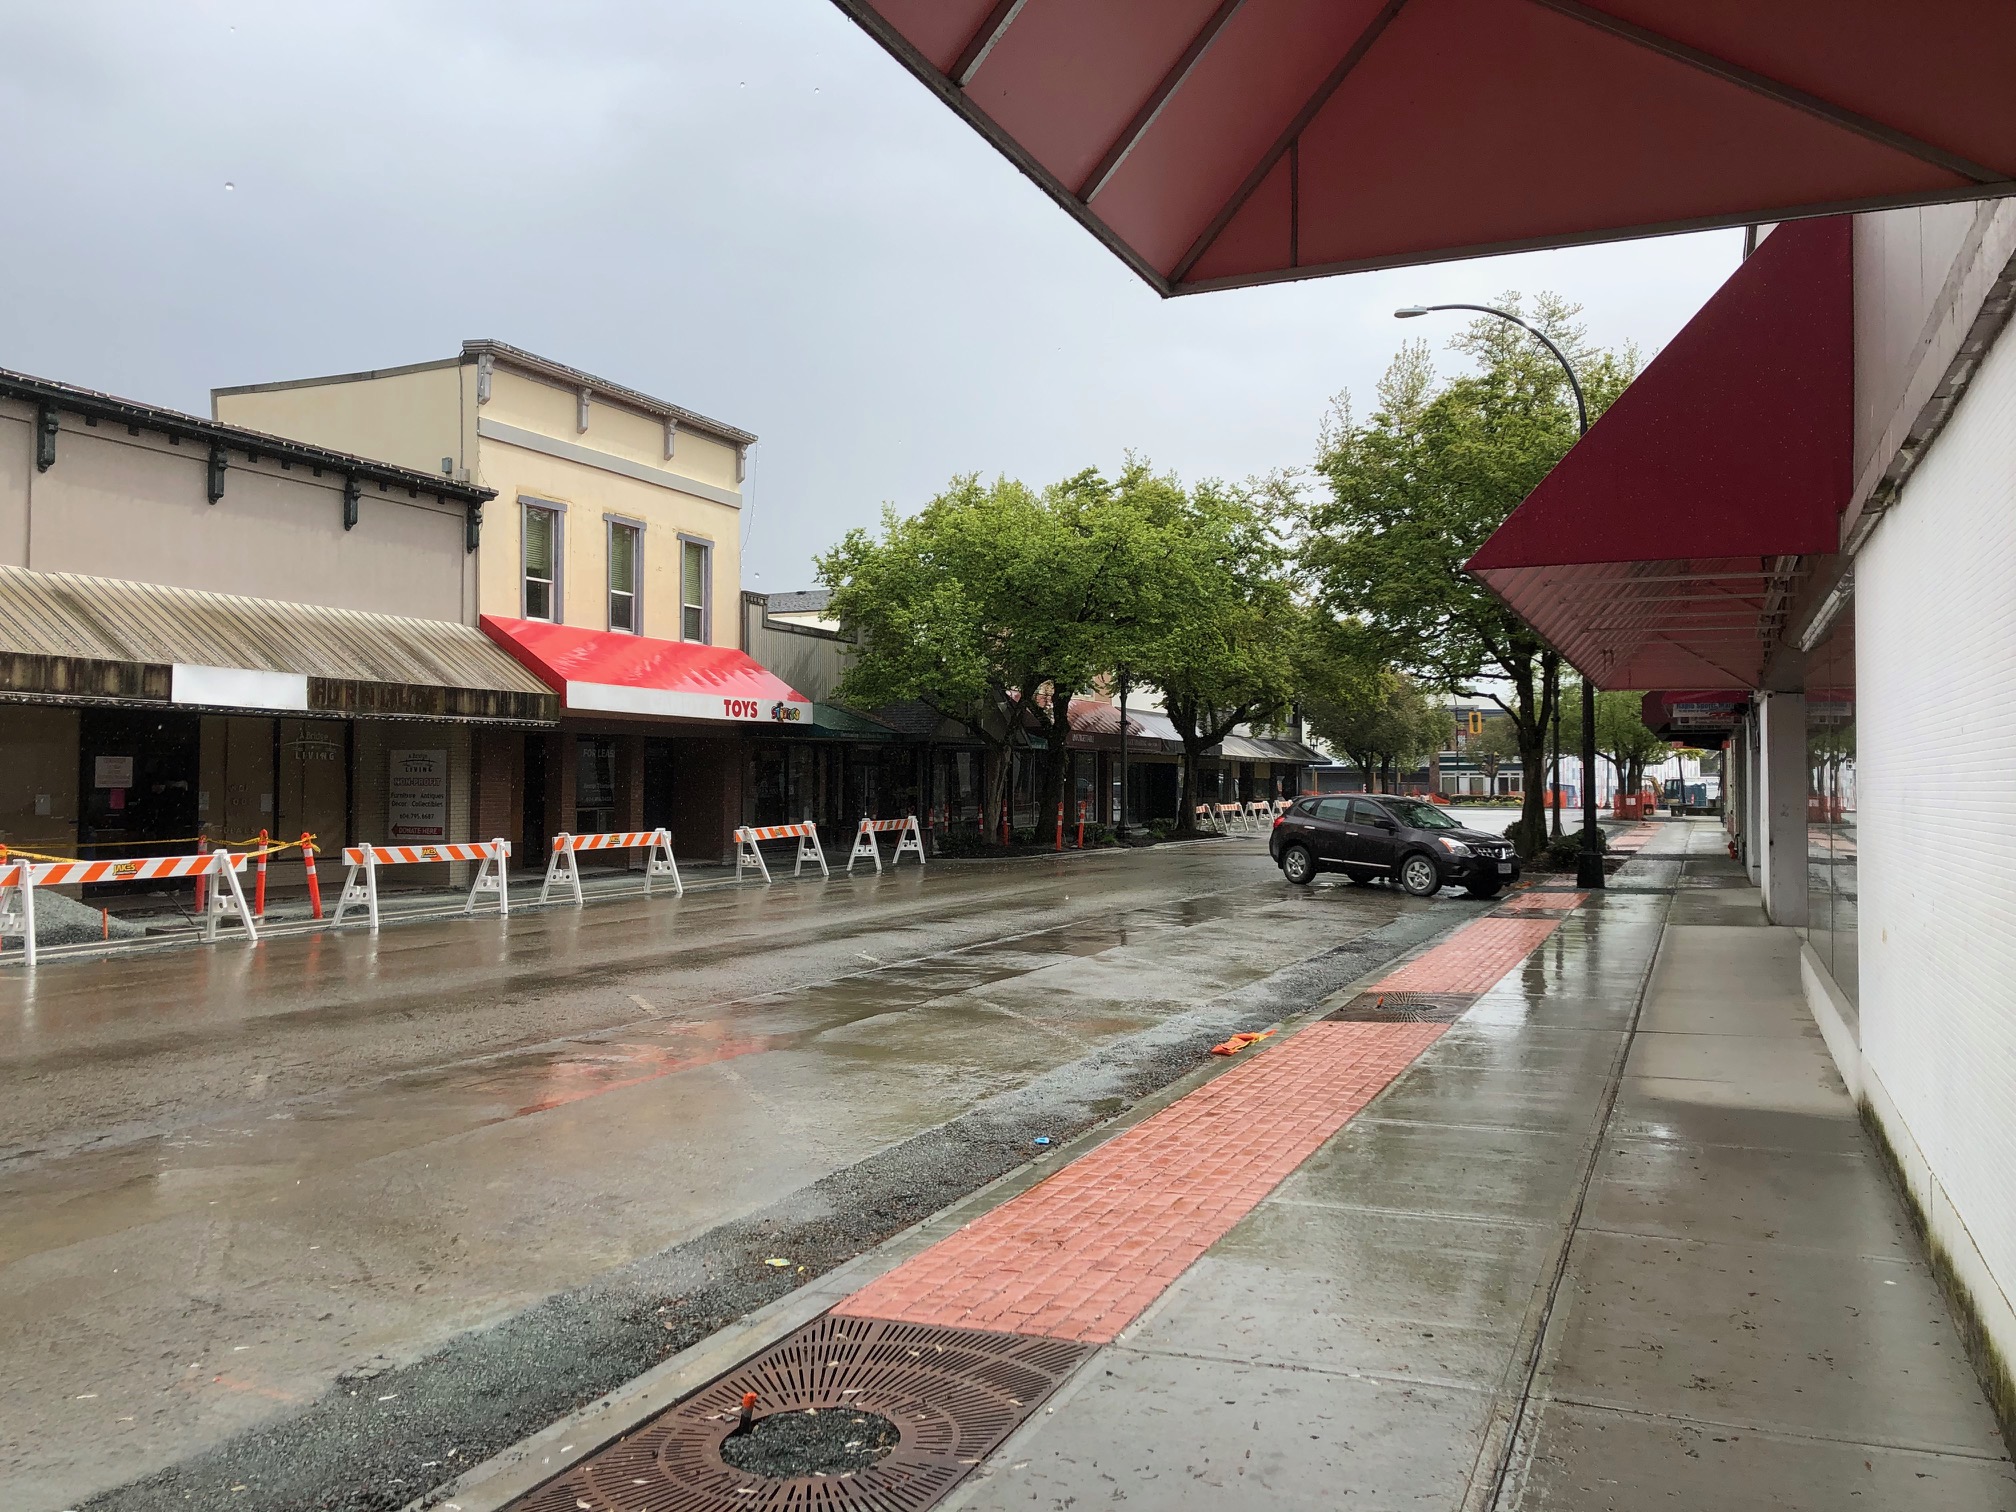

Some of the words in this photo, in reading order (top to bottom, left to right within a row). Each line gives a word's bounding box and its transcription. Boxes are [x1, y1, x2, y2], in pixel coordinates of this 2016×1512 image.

[723, 698, 758, 719] TOYS
[295, 751, 335, 760] LIVING
[583, 748, 597, 757] FOR
[597, 748, 615, 758] LEAS
[393, 777, 441, 787] NON-PROFIT
[420, 792, 444, 800] Antiques
[411, 800, 443, 808] Collectibles
[422, 827, 438, 835] HERE
